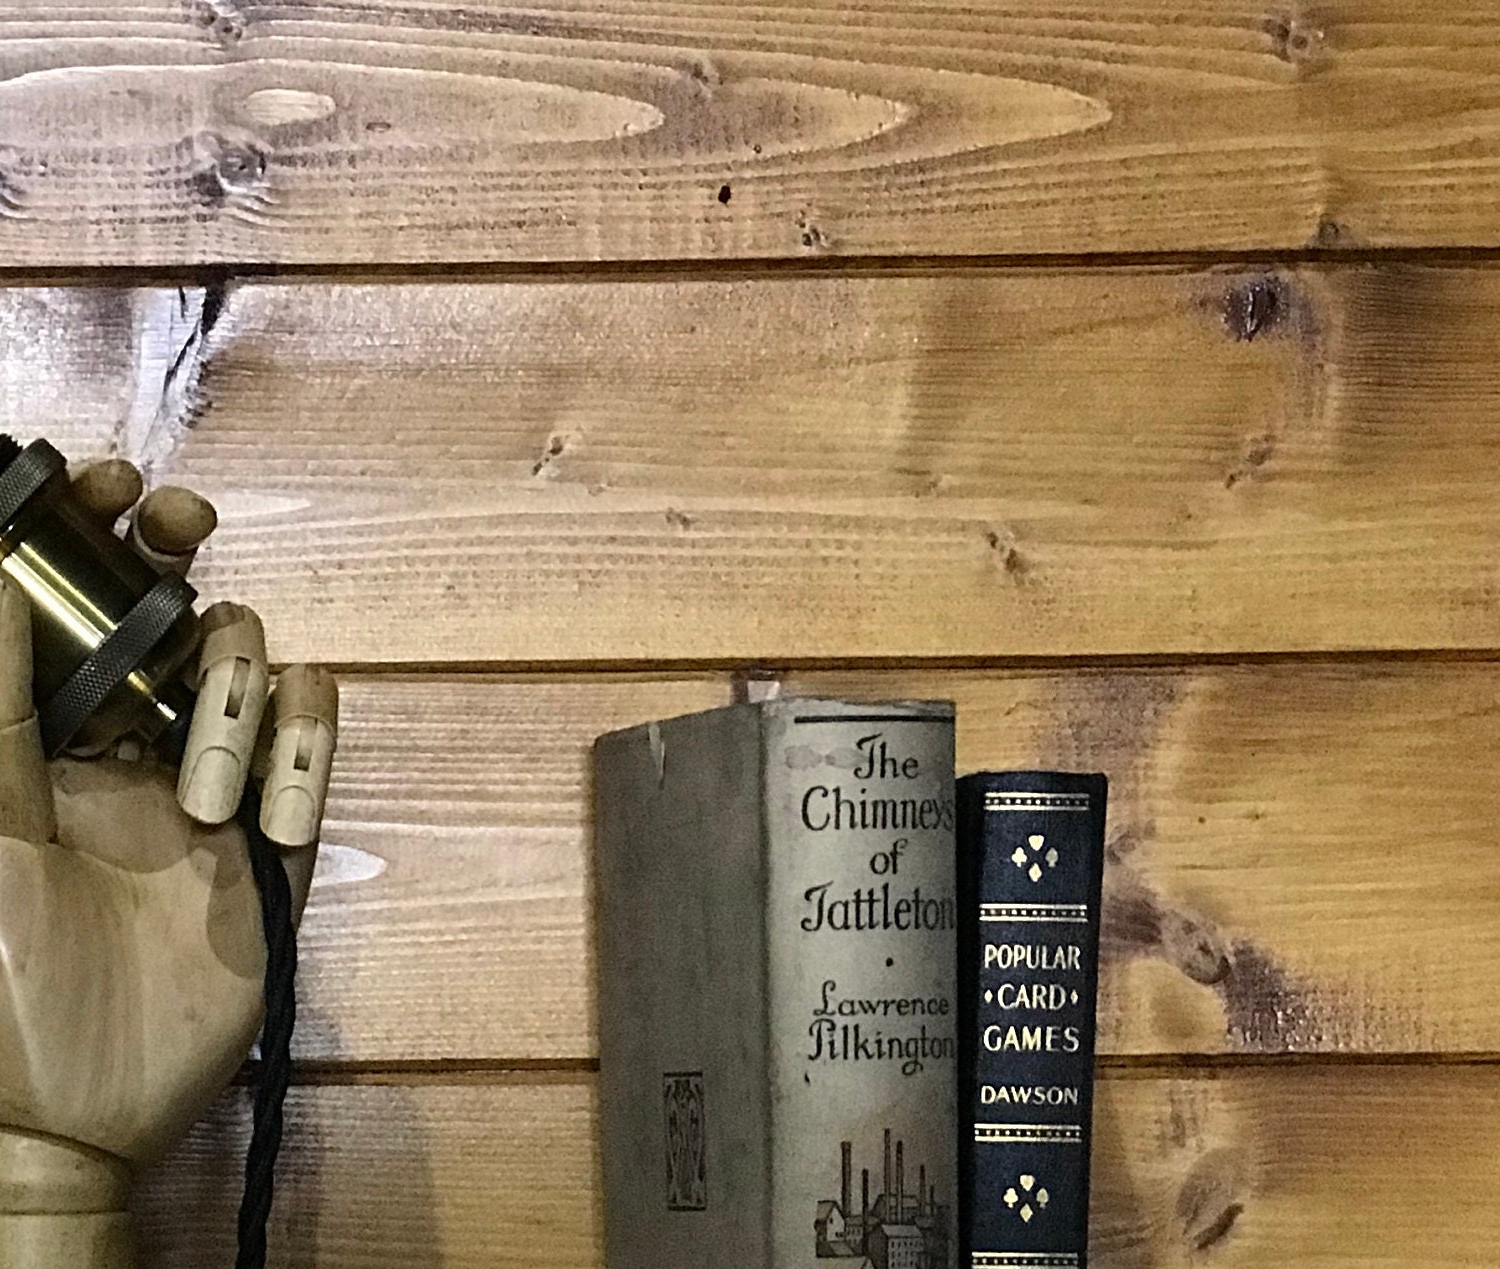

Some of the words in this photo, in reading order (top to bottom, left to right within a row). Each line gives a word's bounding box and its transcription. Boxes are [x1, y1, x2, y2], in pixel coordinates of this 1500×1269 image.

[853, 733, 919, 779] The
[801, 786, 955, 832] Chimneys
[870, 838, 909, 875] of
[801, 880, 956, 932] Tattleton
[984, 944, 1082, 971] POPULAR
[814, 979, 949, 1016] Lawrence
[997, 982, 1067, 1011] CARD
[808, 1018, 955, 1076] Pilkington
[983, 1025, 1081, 1052] GAMES
[980, 1085, 1079, 1105] DAWSON
